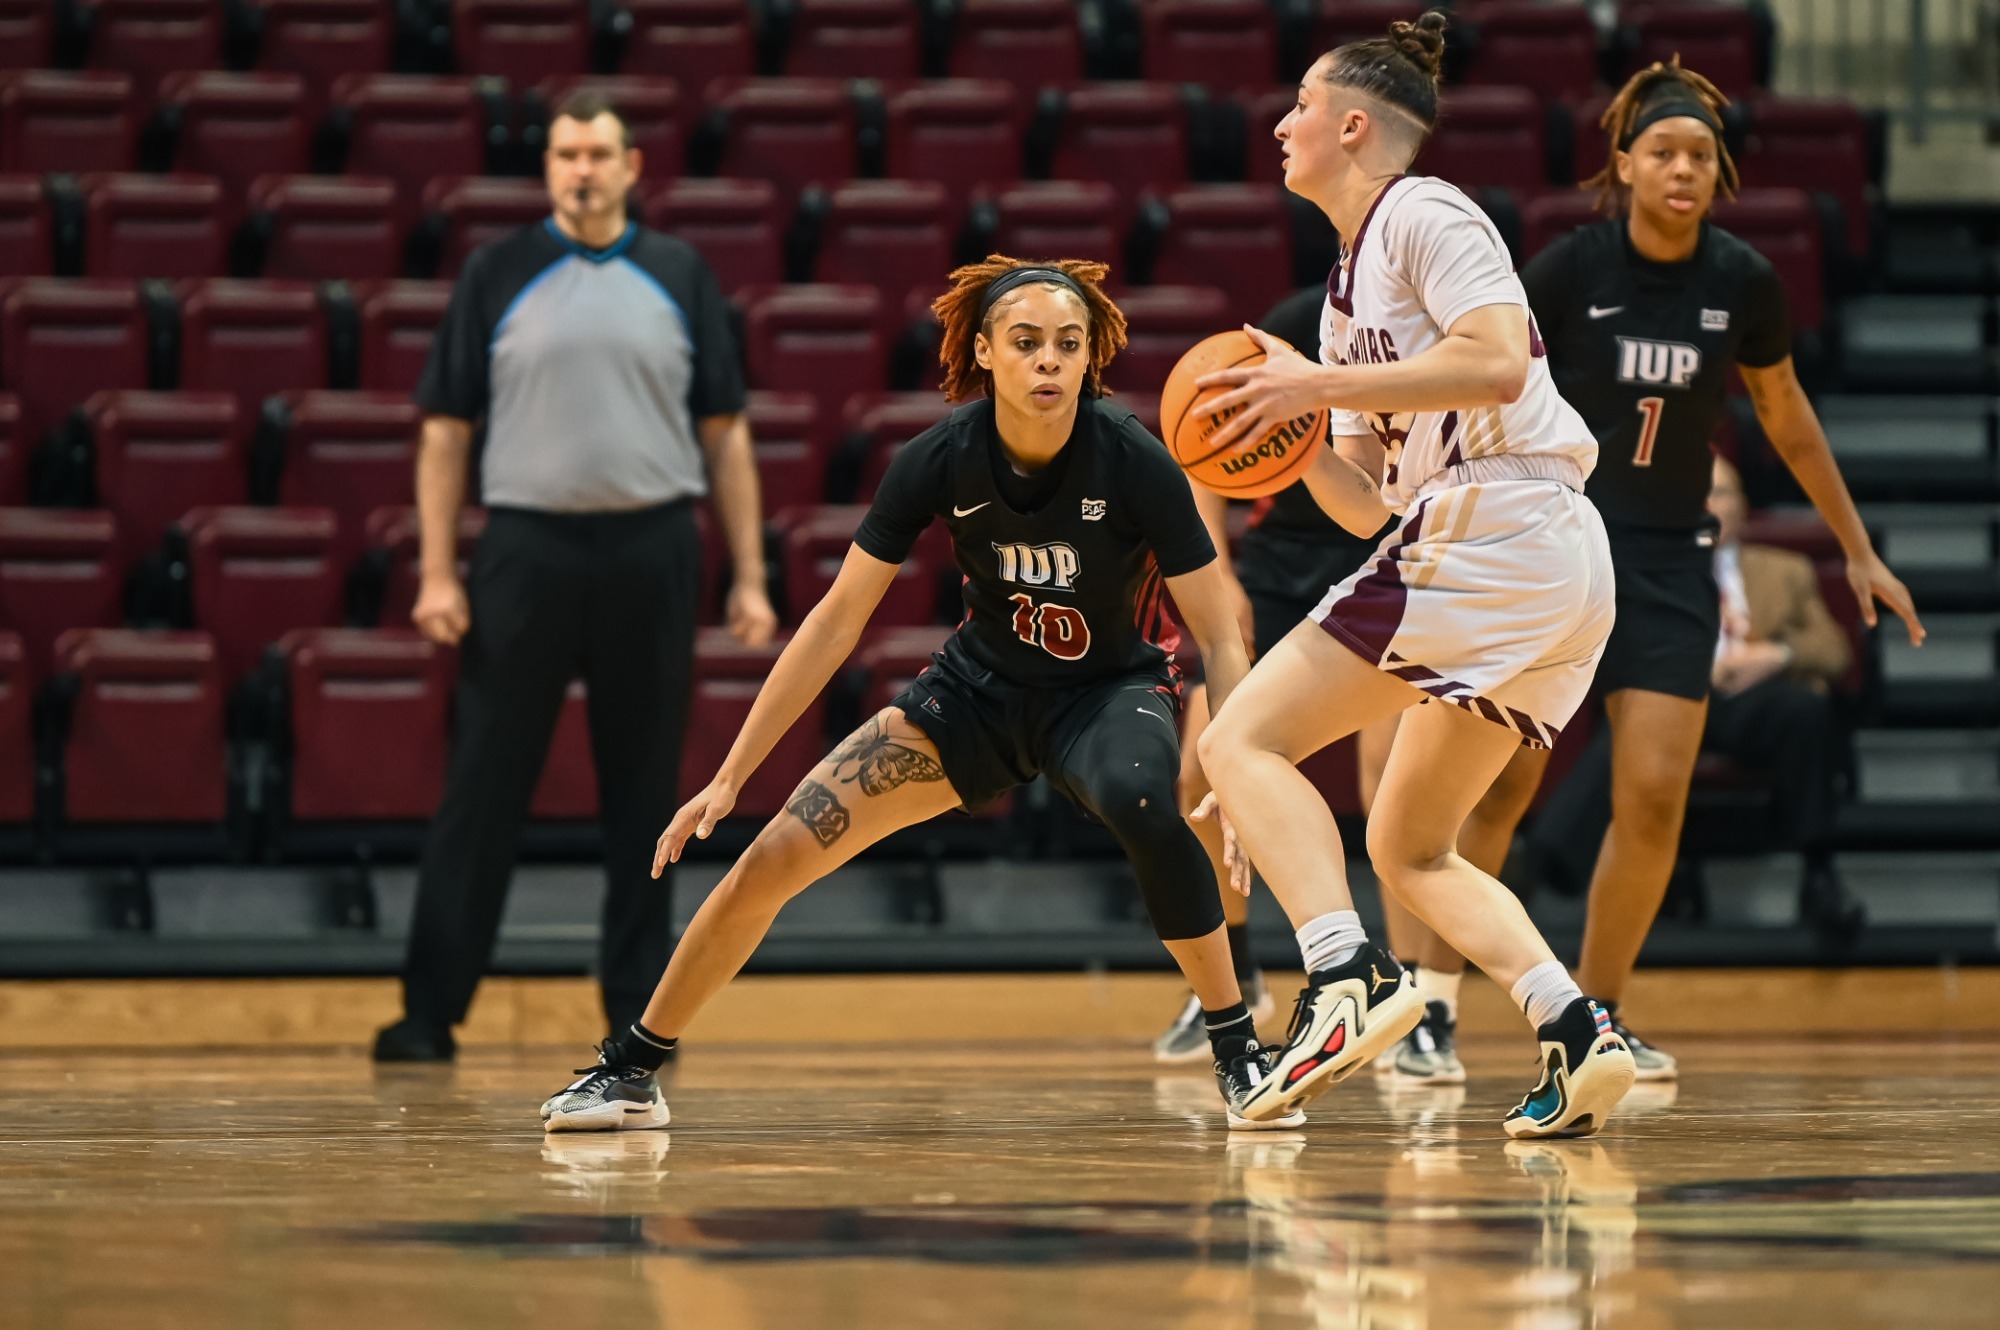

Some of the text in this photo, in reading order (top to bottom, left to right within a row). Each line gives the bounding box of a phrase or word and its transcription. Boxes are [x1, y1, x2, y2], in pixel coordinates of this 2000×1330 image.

[1340, 327, 1400, 365] BURG
[1618, 337, 1701, 386] IUP
[1220, 411, 1317, 475] Wilson
[1632, 397, 1665, 468] 1
[995, 543, 1080, 589] IUP
[1008, 592, 1092, 661] 10
